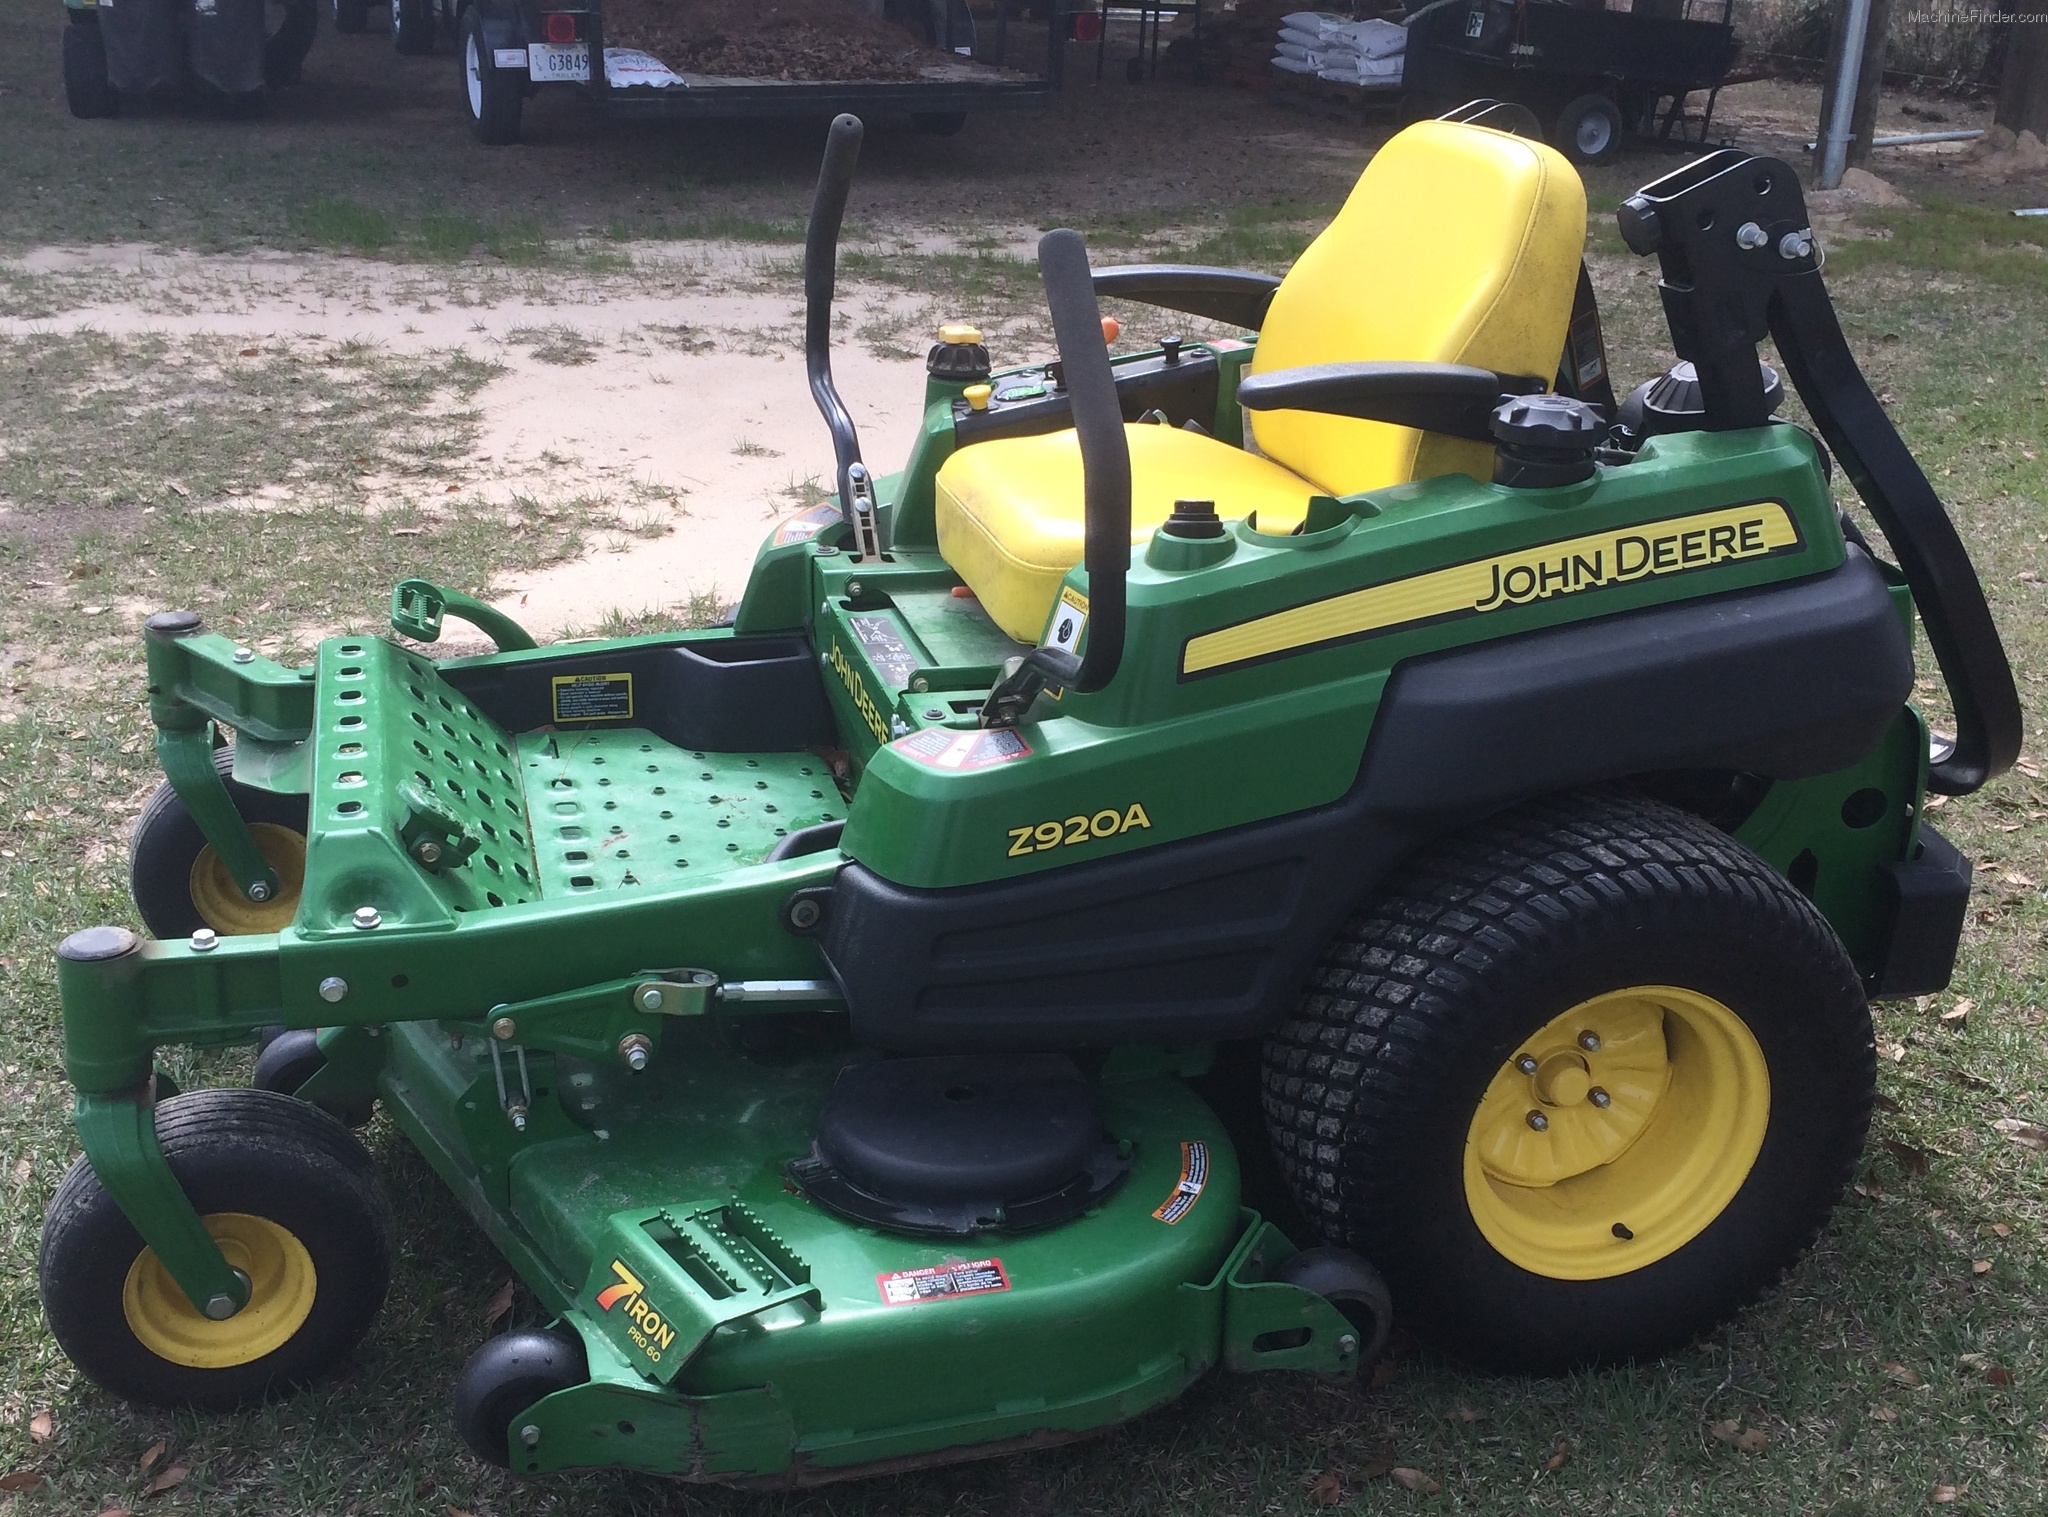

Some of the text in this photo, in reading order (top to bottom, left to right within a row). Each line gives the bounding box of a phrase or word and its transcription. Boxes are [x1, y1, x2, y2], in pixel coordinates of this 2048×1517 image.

[548, 54, 589, 71] G3849
[1475, 518, 1766, 610] JOHN DEERE
[829, 634, 889, 746] JOHN DEERE
[1007, 802, 1152, 858] Z920A
[901, 1267, 936, 1278] DANGER
[623, 1292, 676, 1350] IRON
[627, 1325, 661, 1362] PRO 60
